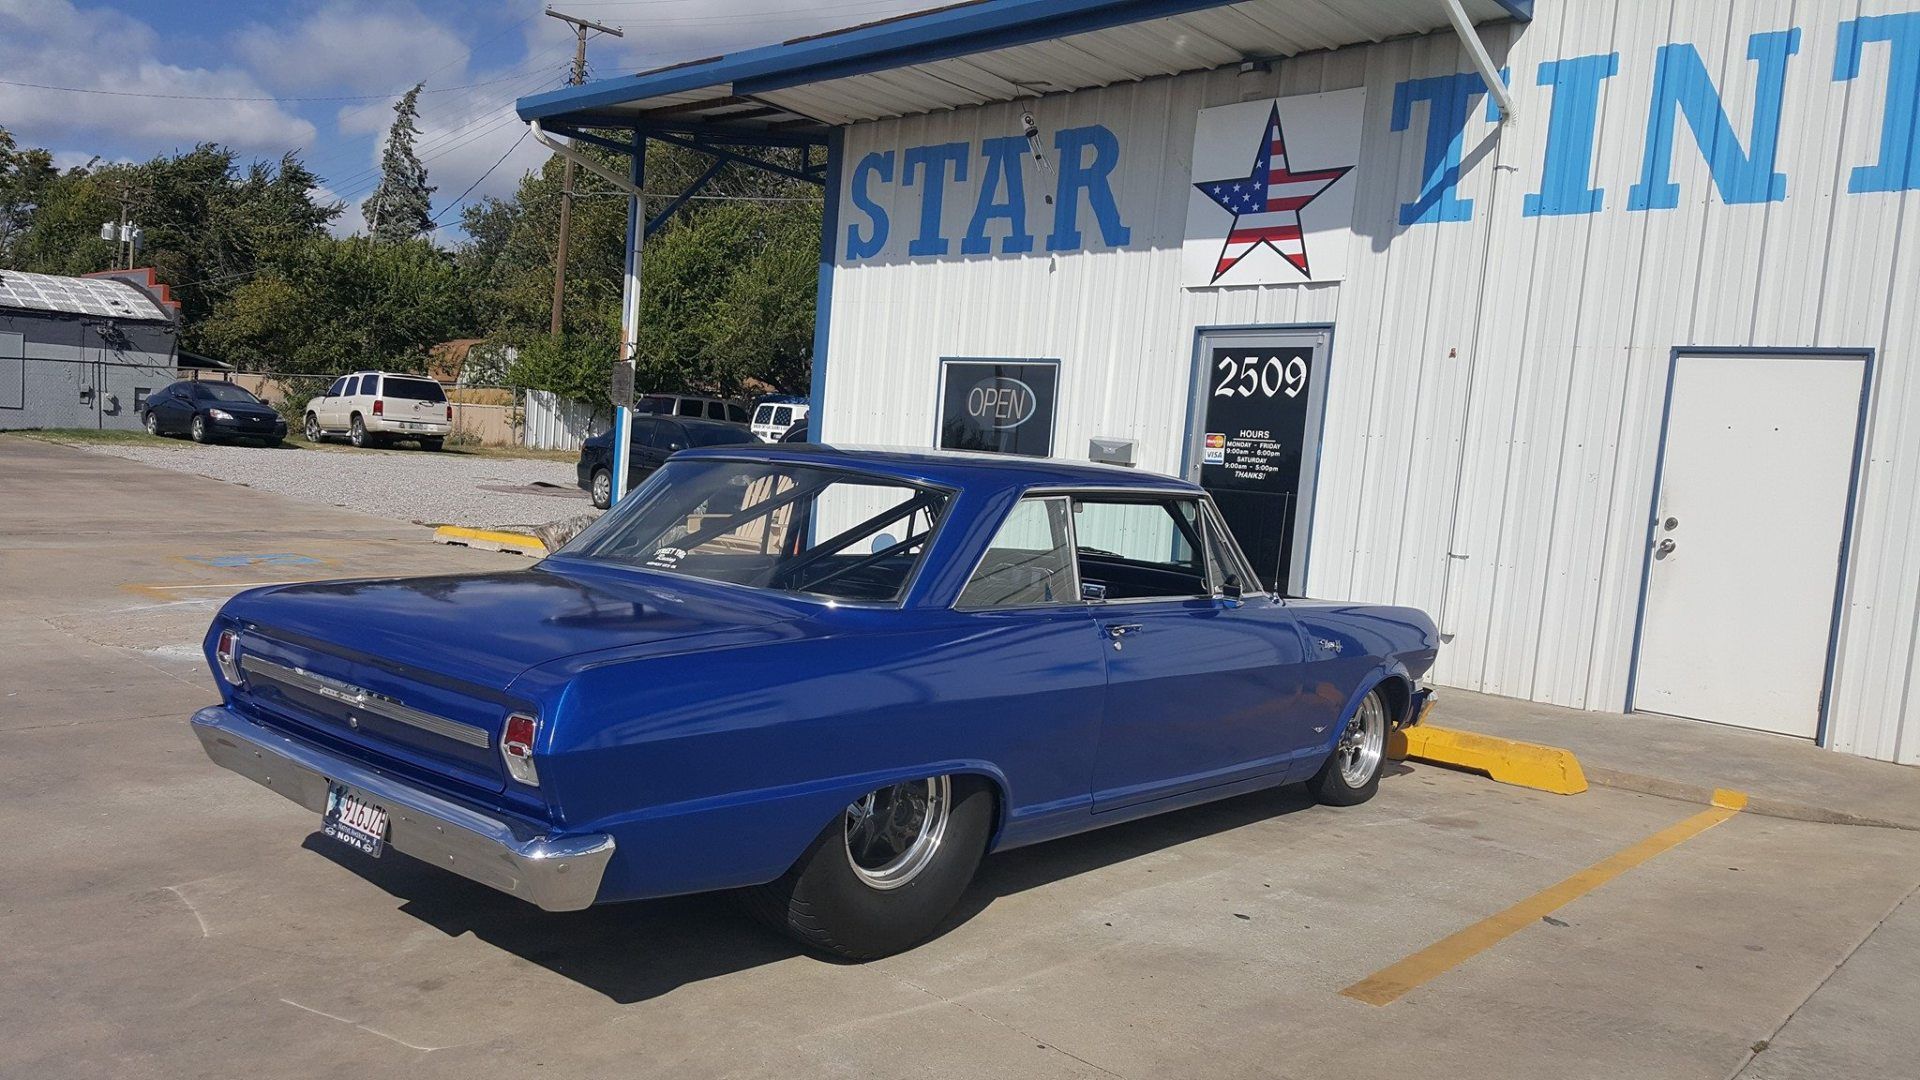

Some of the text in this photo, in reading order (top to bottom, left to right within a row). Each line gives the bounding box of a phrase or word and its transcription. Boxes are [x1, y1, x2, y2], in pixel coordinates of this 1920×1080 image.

[846, 124, 1131, 261] STAR
[1215, 355, 1307, 398] 2509
[968, 387, 1026, 419] OPEN
[1240, 430, 1270, 439] HOURS
[1207, 451, 1223, 459] VISA
[1237, 456, 1268, 464] SATURDAY
[1235, 471, 1267, 480] THANKS!
[337, 831, 362, 848] NOVA
